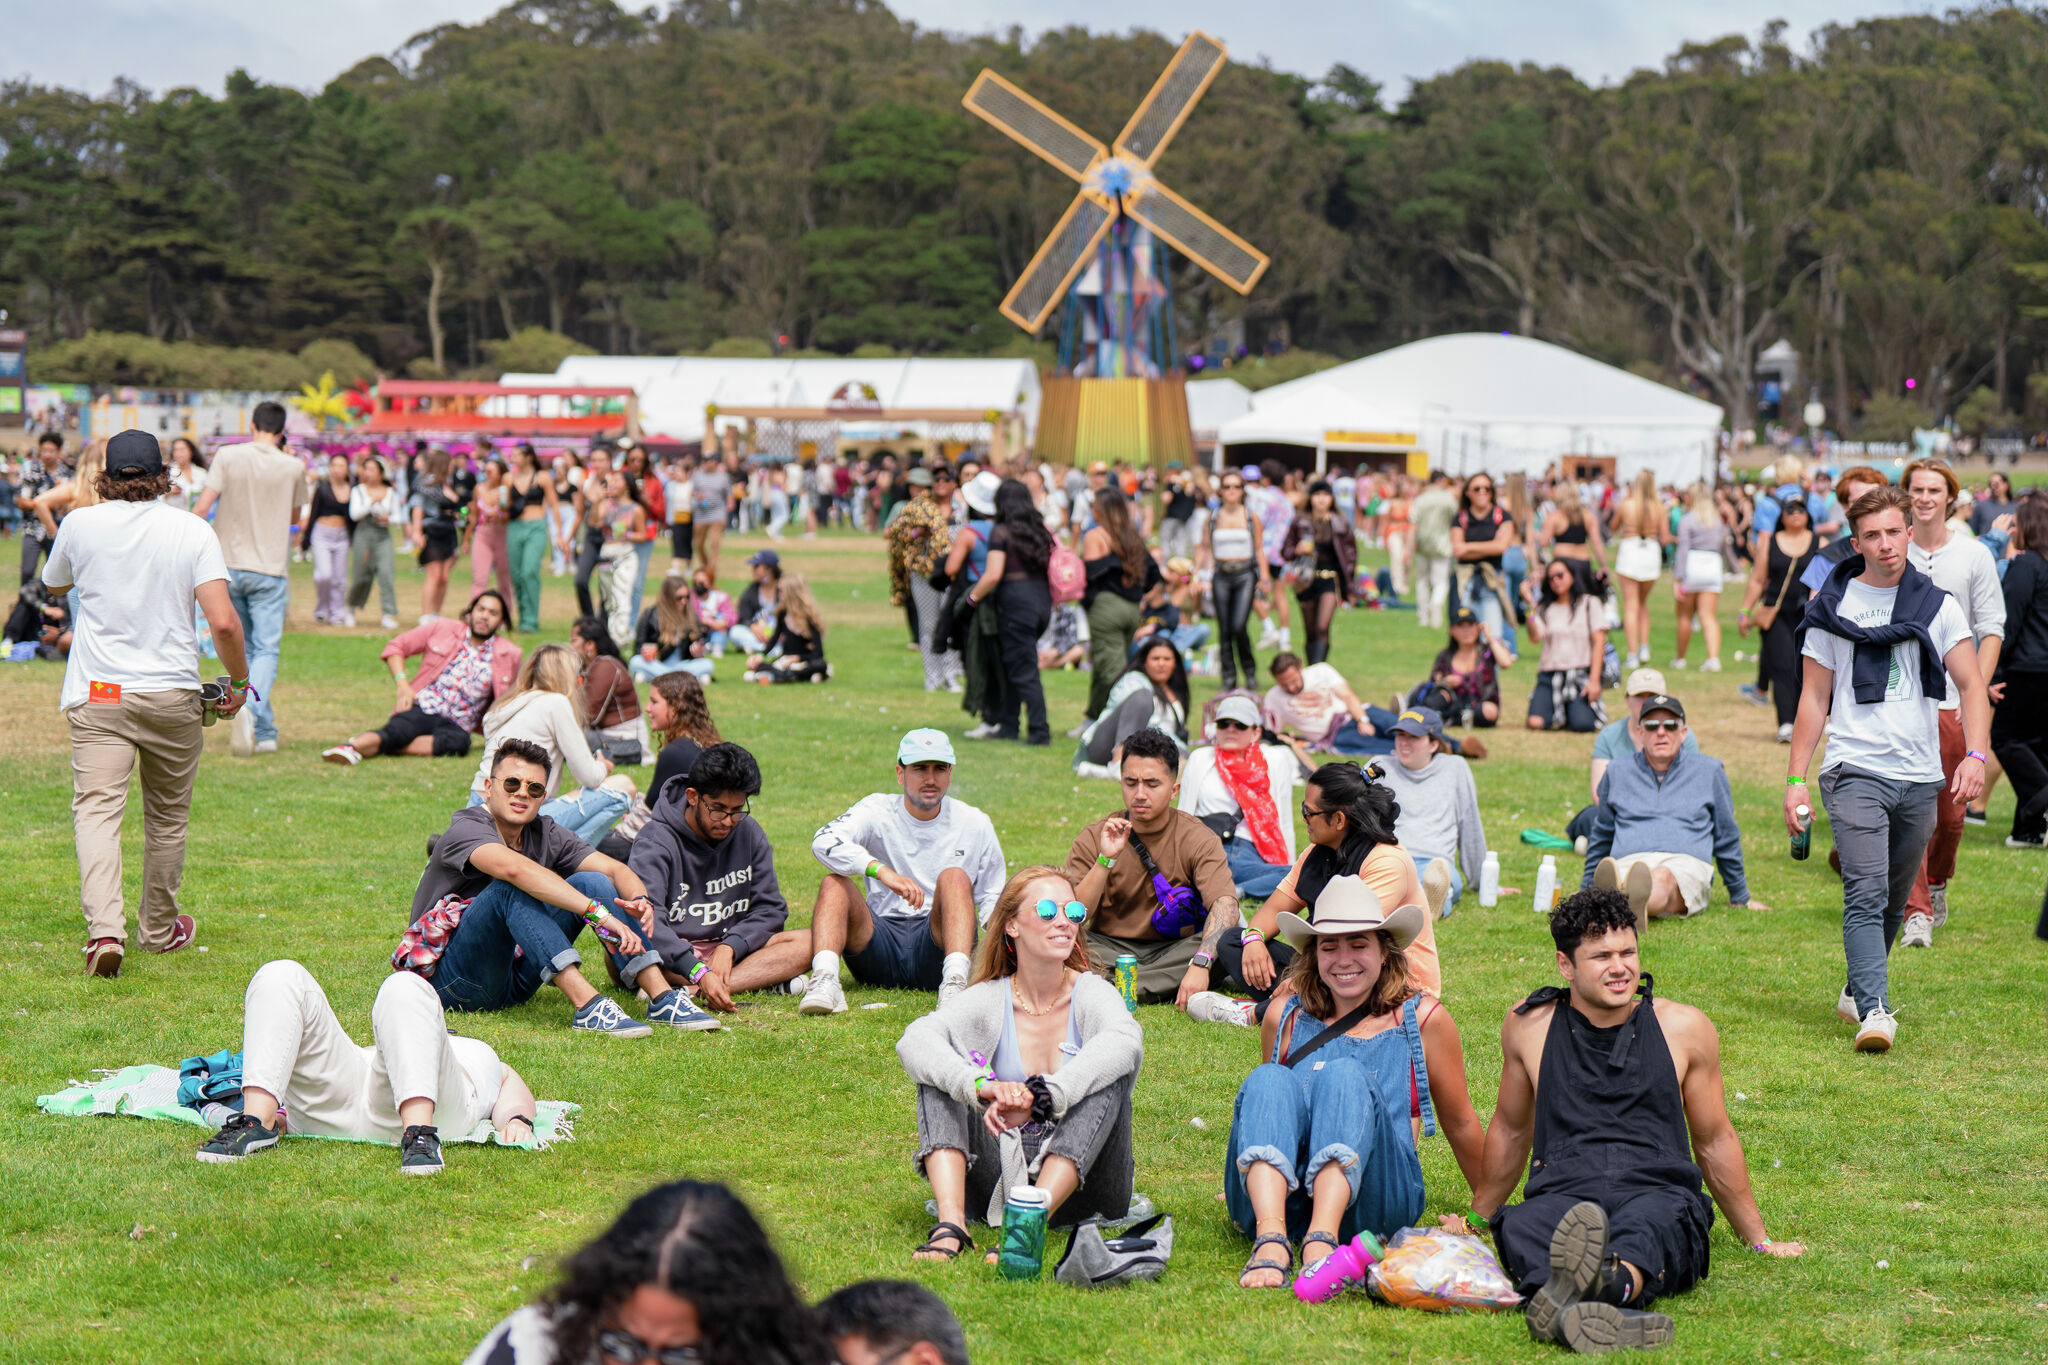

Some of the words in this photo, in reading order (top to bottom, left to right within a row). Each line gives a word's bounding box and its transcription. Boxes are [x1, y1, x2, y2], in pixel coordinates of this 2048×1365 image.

[1853, 609, 1893, 623] BREATHI
[705, 864, 752, 895] must
[669, 900, 687, 922] be
[688, 898, 749, 926] Born
